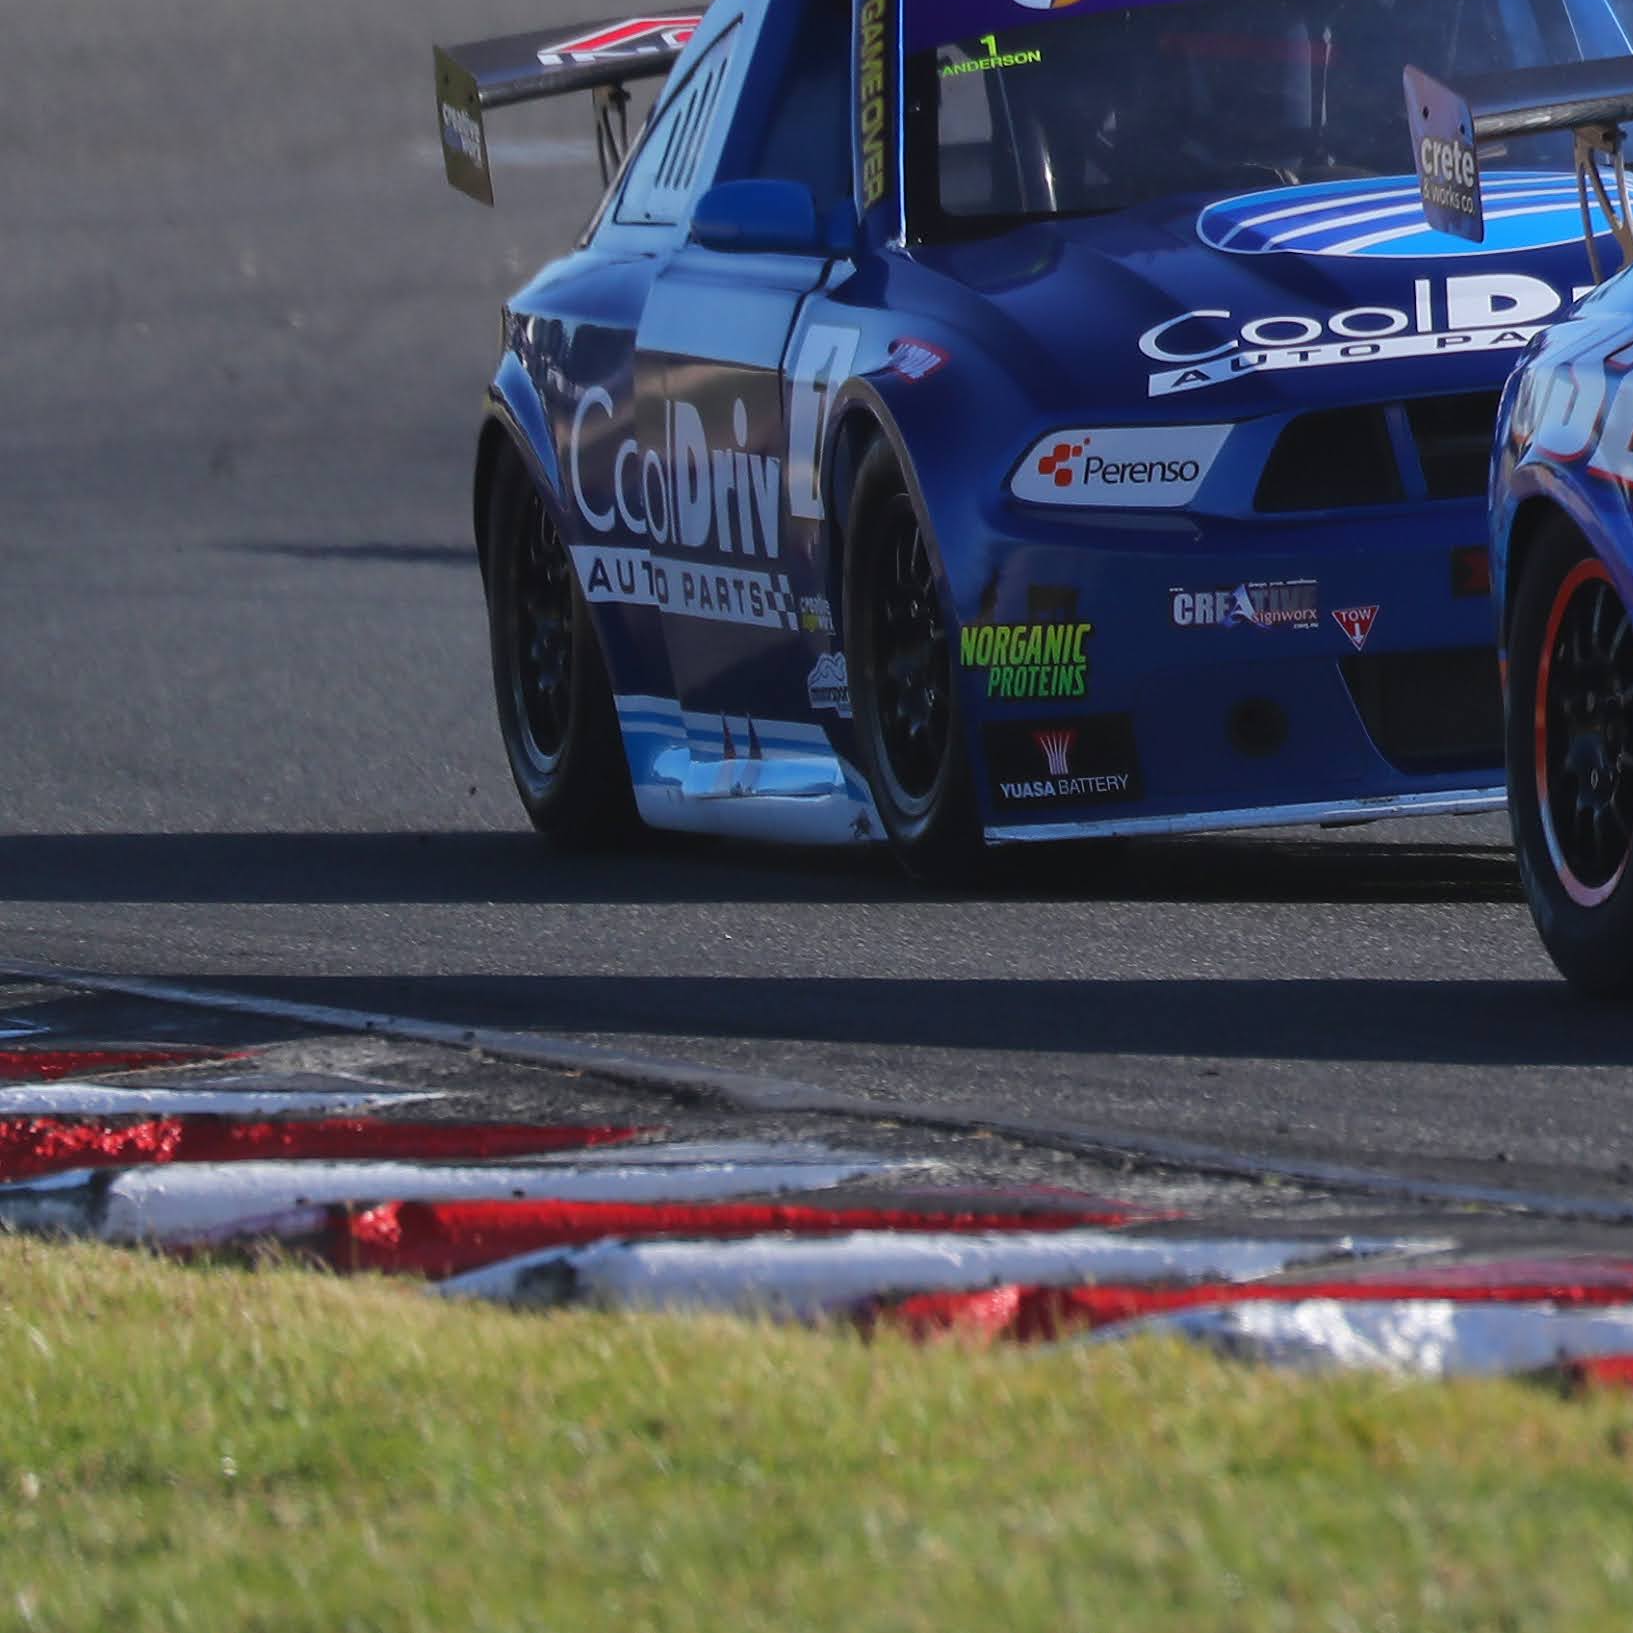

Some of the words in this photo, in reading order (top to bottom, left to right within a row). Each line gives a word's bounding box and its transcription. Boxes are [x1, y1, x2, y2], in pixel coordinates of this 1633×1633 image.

[980, 34, 998, 57] 1
[942, 49, 1042, 78] ANDERSON
[1421, 137, 1475, 188] crete
[1432, 183, 1461, 209] works
[1138, 273, 1598, 363] CoolD
[1169, 342, 1381, 389] AUTO
[1083, 456, 1200, 485] Perenso
[588, 557, 669, 605] AUTO
[681, 571, 764, 617] PARTS
[1339, 609, 1373, 622] TOW
[960, 623, 1092, 667] NORGANIC
[987, 665, 1088, 698] PROTEINS
[1000, 779, 1057, 801] YUASA
[1058, 774, 1130, 797] BATTERY
